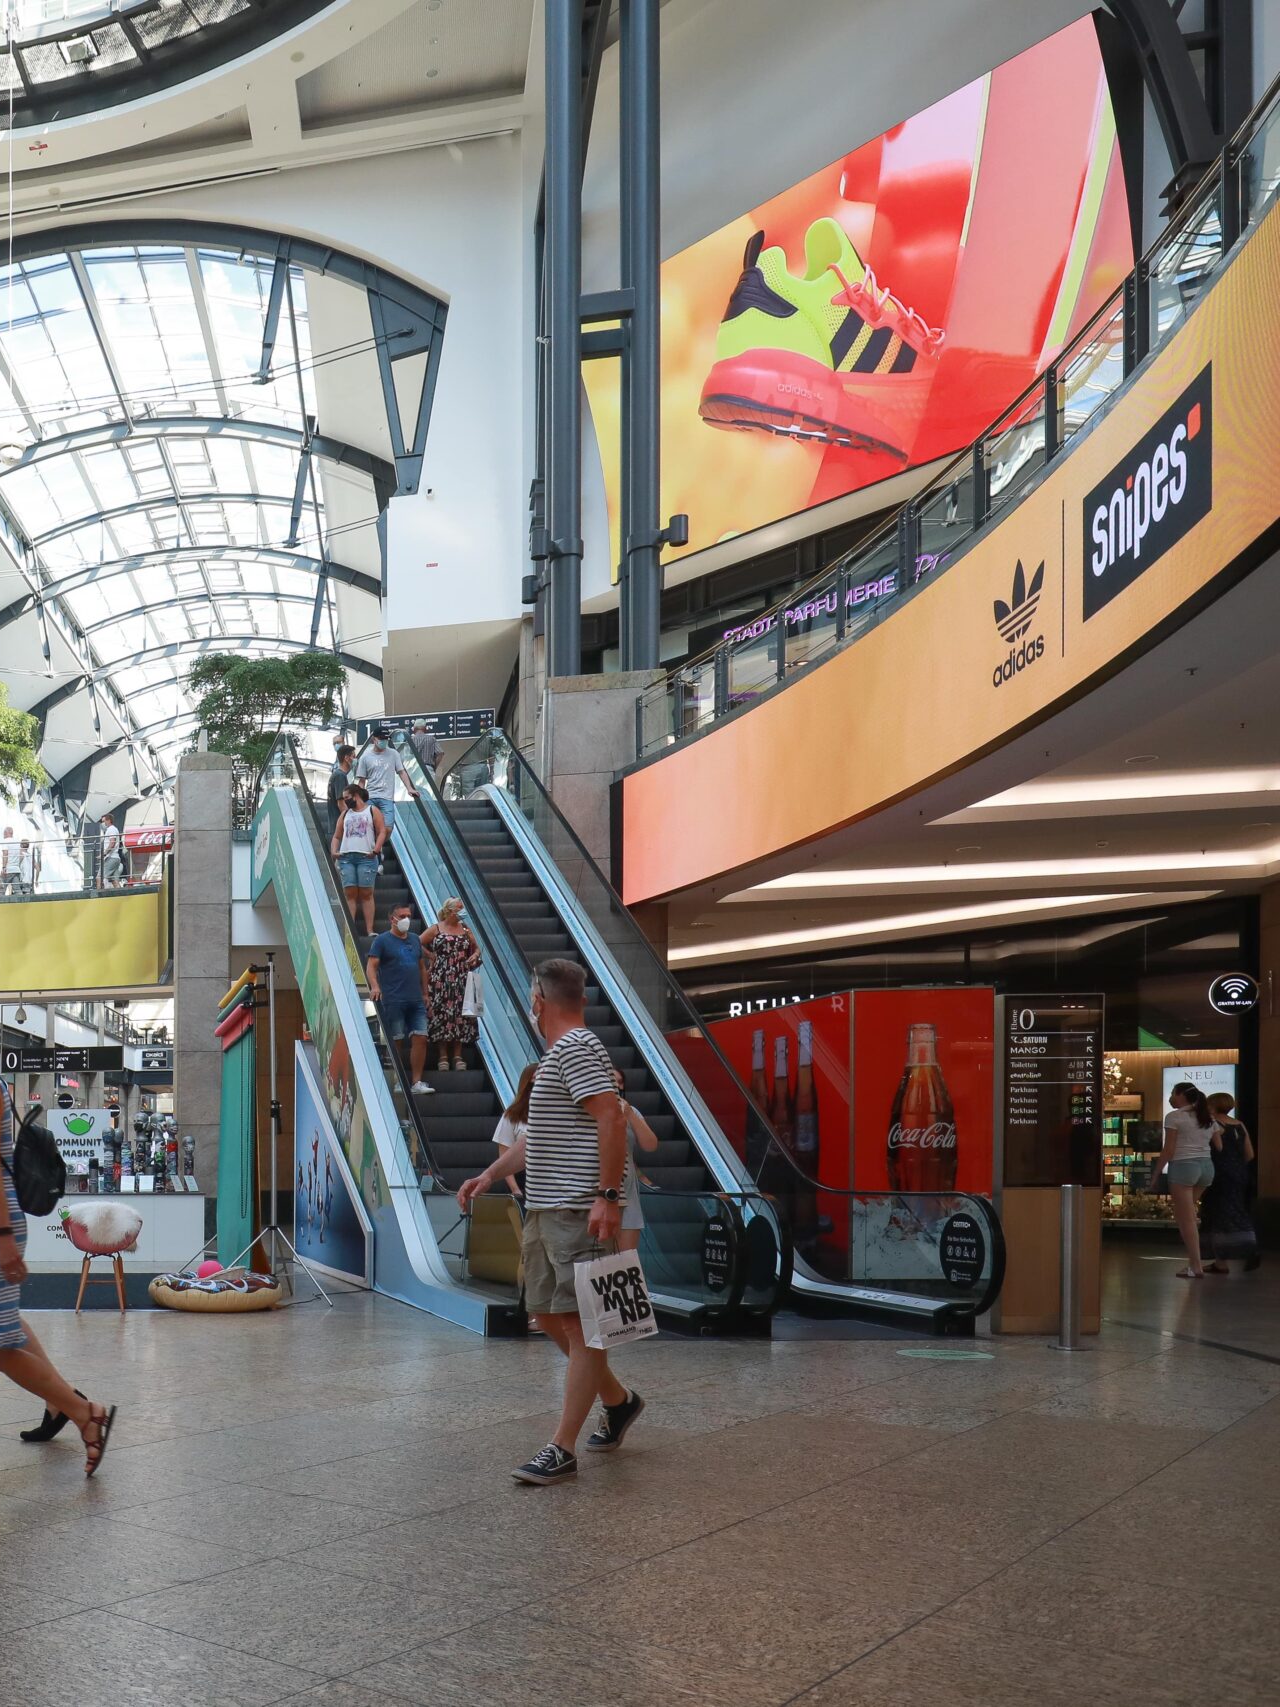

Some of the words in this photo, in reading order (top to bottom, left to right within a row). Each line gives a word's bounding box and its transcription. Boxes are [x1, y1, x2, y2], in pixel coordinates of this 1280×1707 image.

[1092, 423, 1187, 577] snipes
[993, 635, 1045, 688] adidas
[1019, 1008, 1035, 1030] 0
[1023, 1036, 1048, 1044] SATURN
[1184, 1071, 1214, 1080] NEU
[56, 1138, 102, 1147] OMMUNIT
[887, 1122, 956, 1149] Coca-Cola
[590, 1266, 643, 1296] WOR
